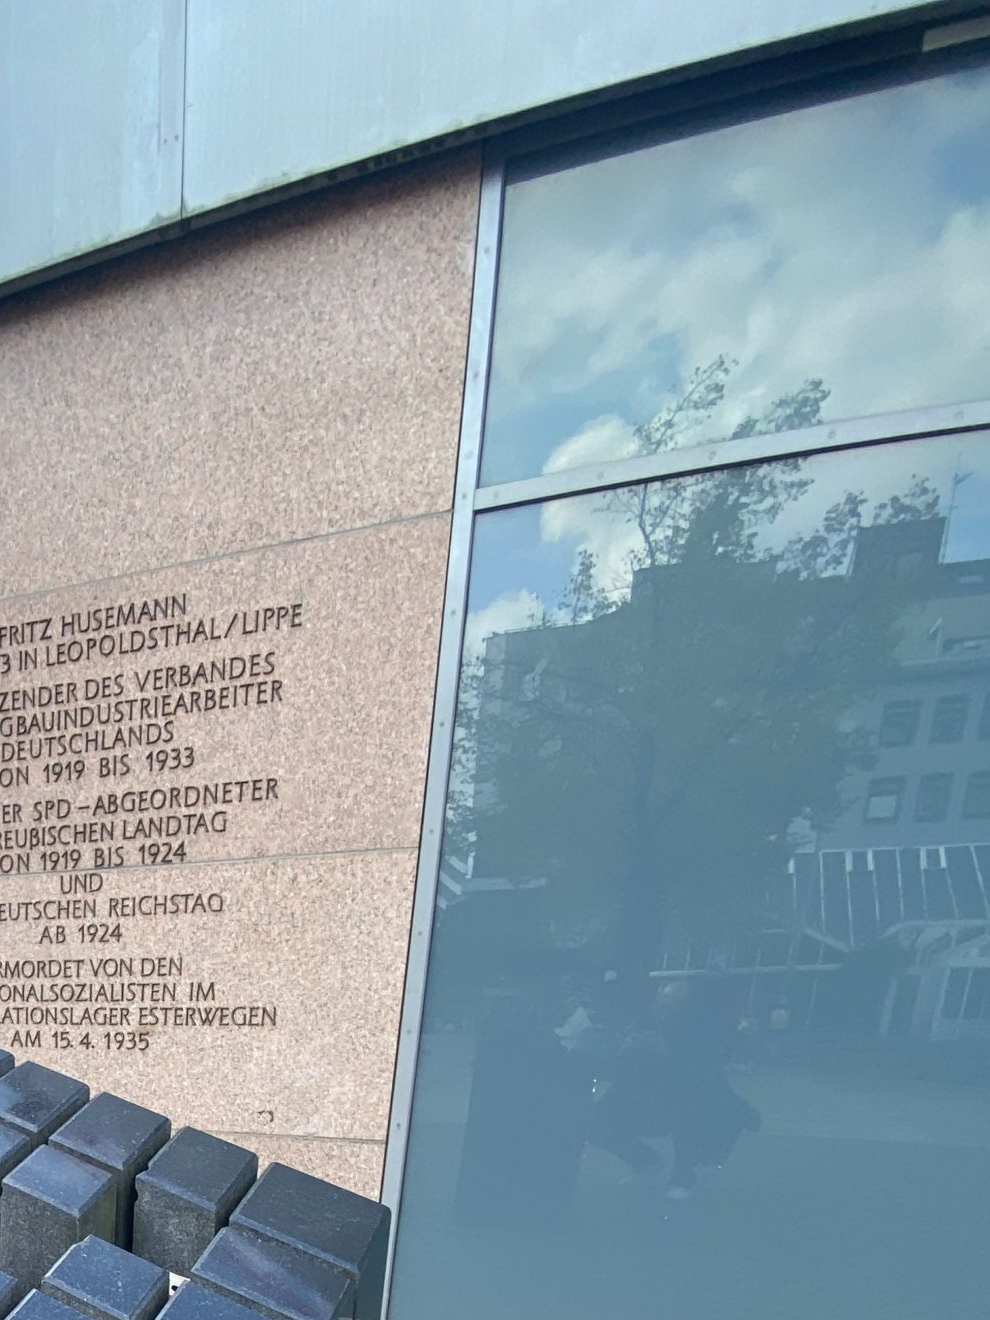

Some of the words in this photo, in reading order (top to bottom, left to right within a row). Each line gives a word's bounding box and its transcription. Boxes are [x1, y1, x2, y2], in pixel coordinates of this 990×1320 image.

[60, 592, 187, 638] HUSEMANN
[18, 647, 38, 672] IN
[46, 602, 303, 667] LEOPOLDSTHAL/LIPPE
[85, 673, 125, 701] DES
[134, 651, 276, 694] VERBANDES
[2, 720, 174, 763] DEUTSCHLANDS
[43, 759, 86, 784] 1919
[99, 753, 130, 778] BIS
[145, 746, 195, 773] 1933
[122, 811, 228, 841] LANDTAG
[39, 850, 82, 872] 1919
[94, 846, 125, 868] BIS
[138, 840, 187, 865] 1924
[60, 872, 104, 895] UND
[39, 926, 67, 944] AB
[78, 923, 123, 944] 1924
[89, 957, 133, 978] VON
[141, 956, 184, 977] DEN
[189, 982, 216, 1001] IM
[138, 1006, 277, 1028] ESTERWEGEN
[10, 1030, 42, 1049] AM
[52, 1031, 74, 1050] 15.
[80, 1032, 95, 1050] 4.
[103, 1031, 150, 1051] 1935
